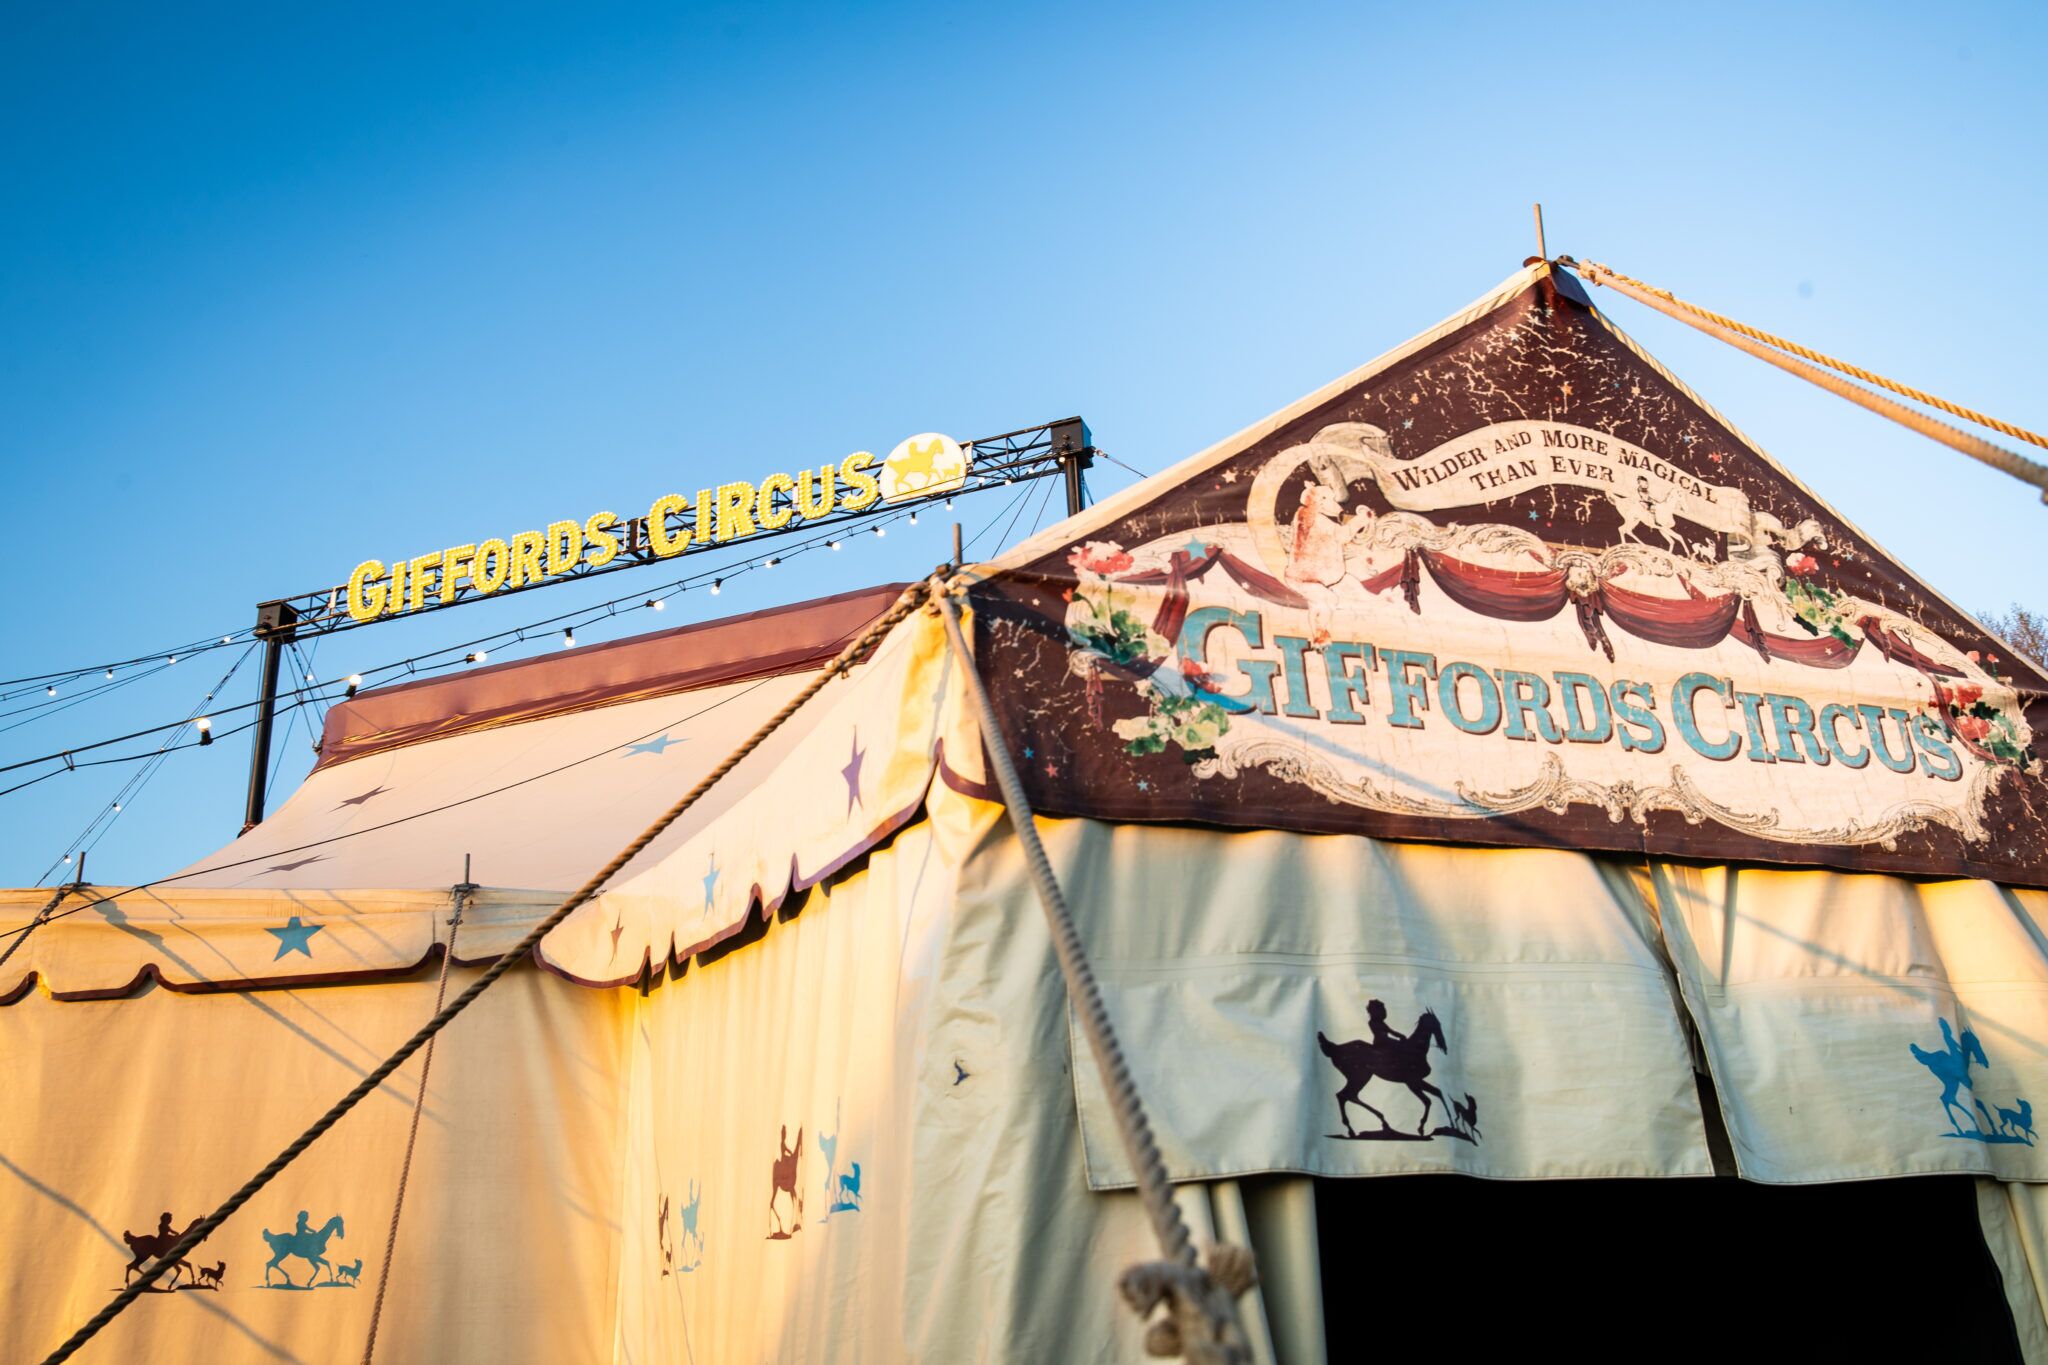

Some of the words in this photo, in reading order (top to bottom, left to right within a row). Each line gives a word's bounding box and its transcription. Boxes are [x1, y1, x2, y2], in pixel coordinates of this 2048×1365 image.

[1469, 459, 1538, 491] THAN
[1550, 455, 1615, 483] EVER
[1494, 430, 1532, 455] AND
[1541, 429, 1609, 456] MORE
[1618, 447, 1718, 504] MAGICAL
[346, 510, 620, 623] GIFFORDS
[647, 450, 881, 559] CIRCUS
[1176, 605, 1668, 755] GIFFORDS
[1671, 672, 1963, 782] CIRCUS
